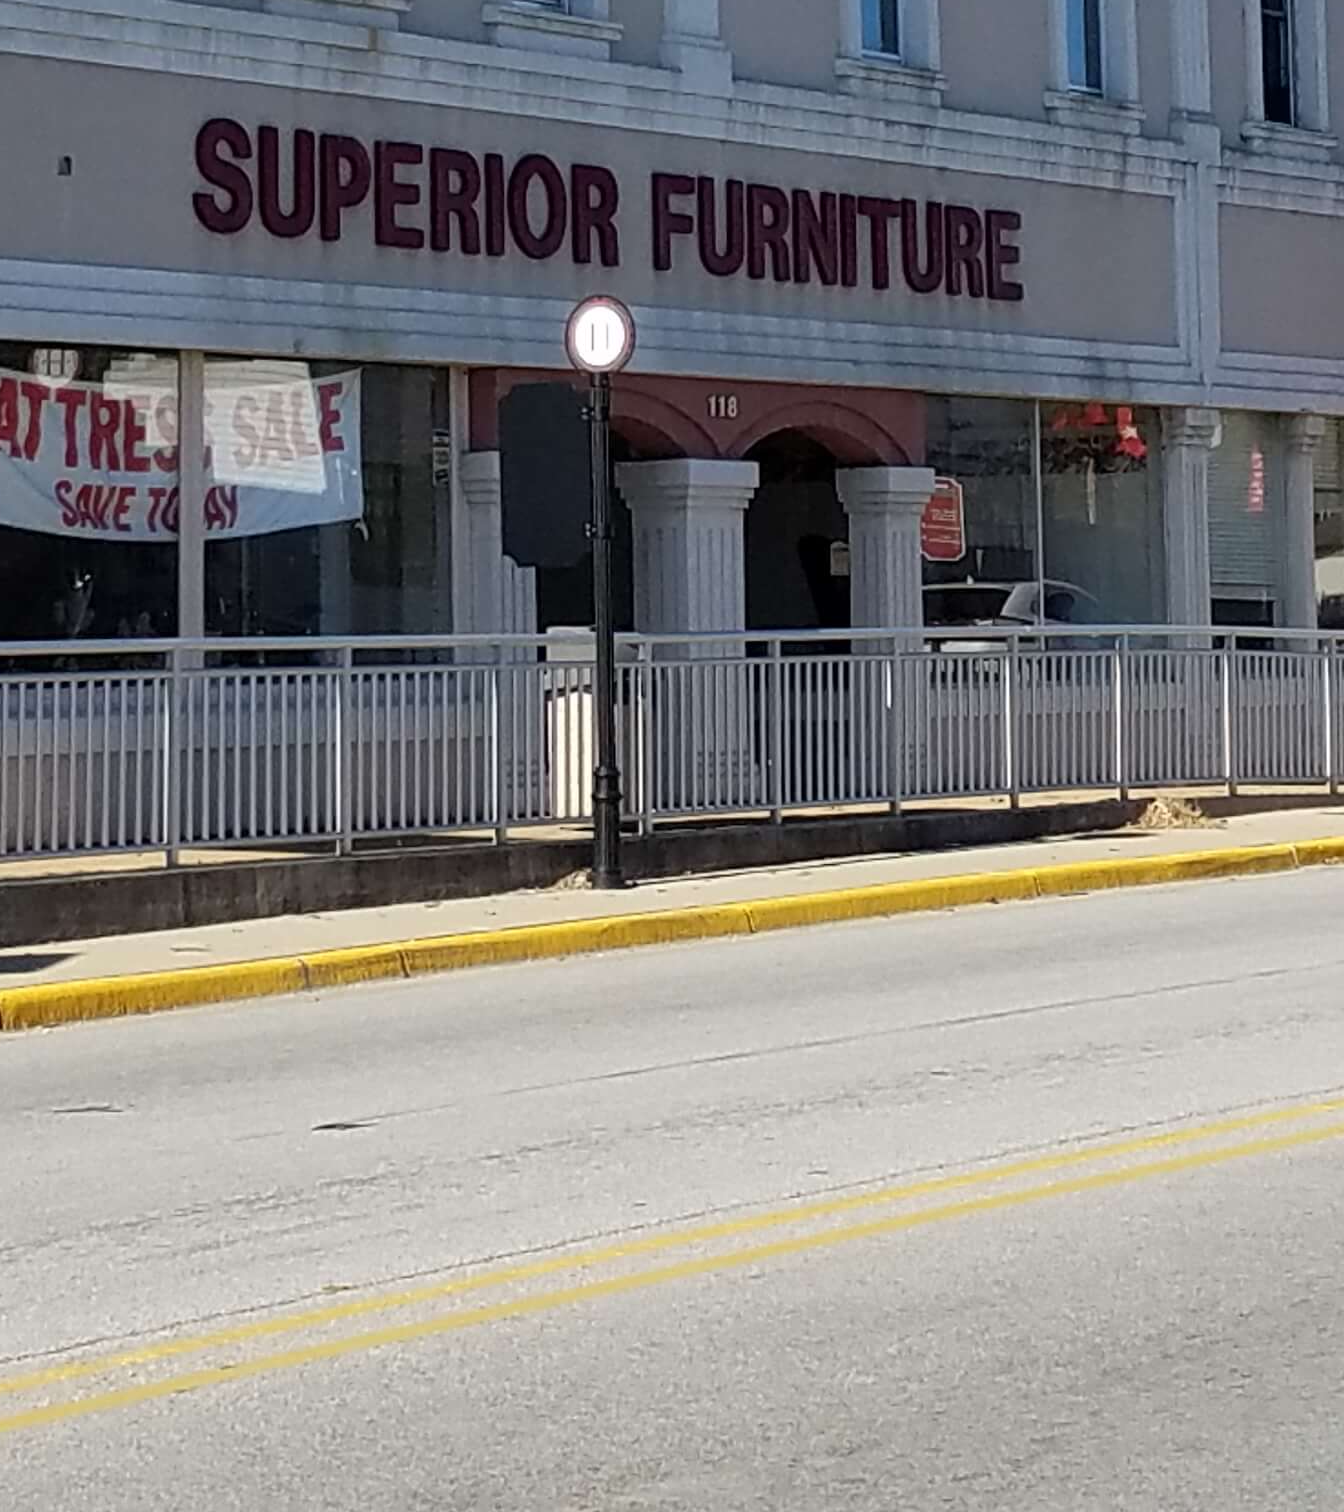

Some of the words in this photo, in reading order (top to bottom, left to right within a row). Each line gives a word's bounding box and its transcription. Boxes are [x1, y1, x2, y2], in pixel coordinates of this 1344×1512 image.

[191, 116, 621, 268] SUPERIOR
[649, 170, 1025, 301] FURNITURE
[232, 381, 346, 469] SALE
[706, 394, 739, 418] 118
[55, 480, 131, 532] SAVE
[147, 484, 240, 534] TOAY
